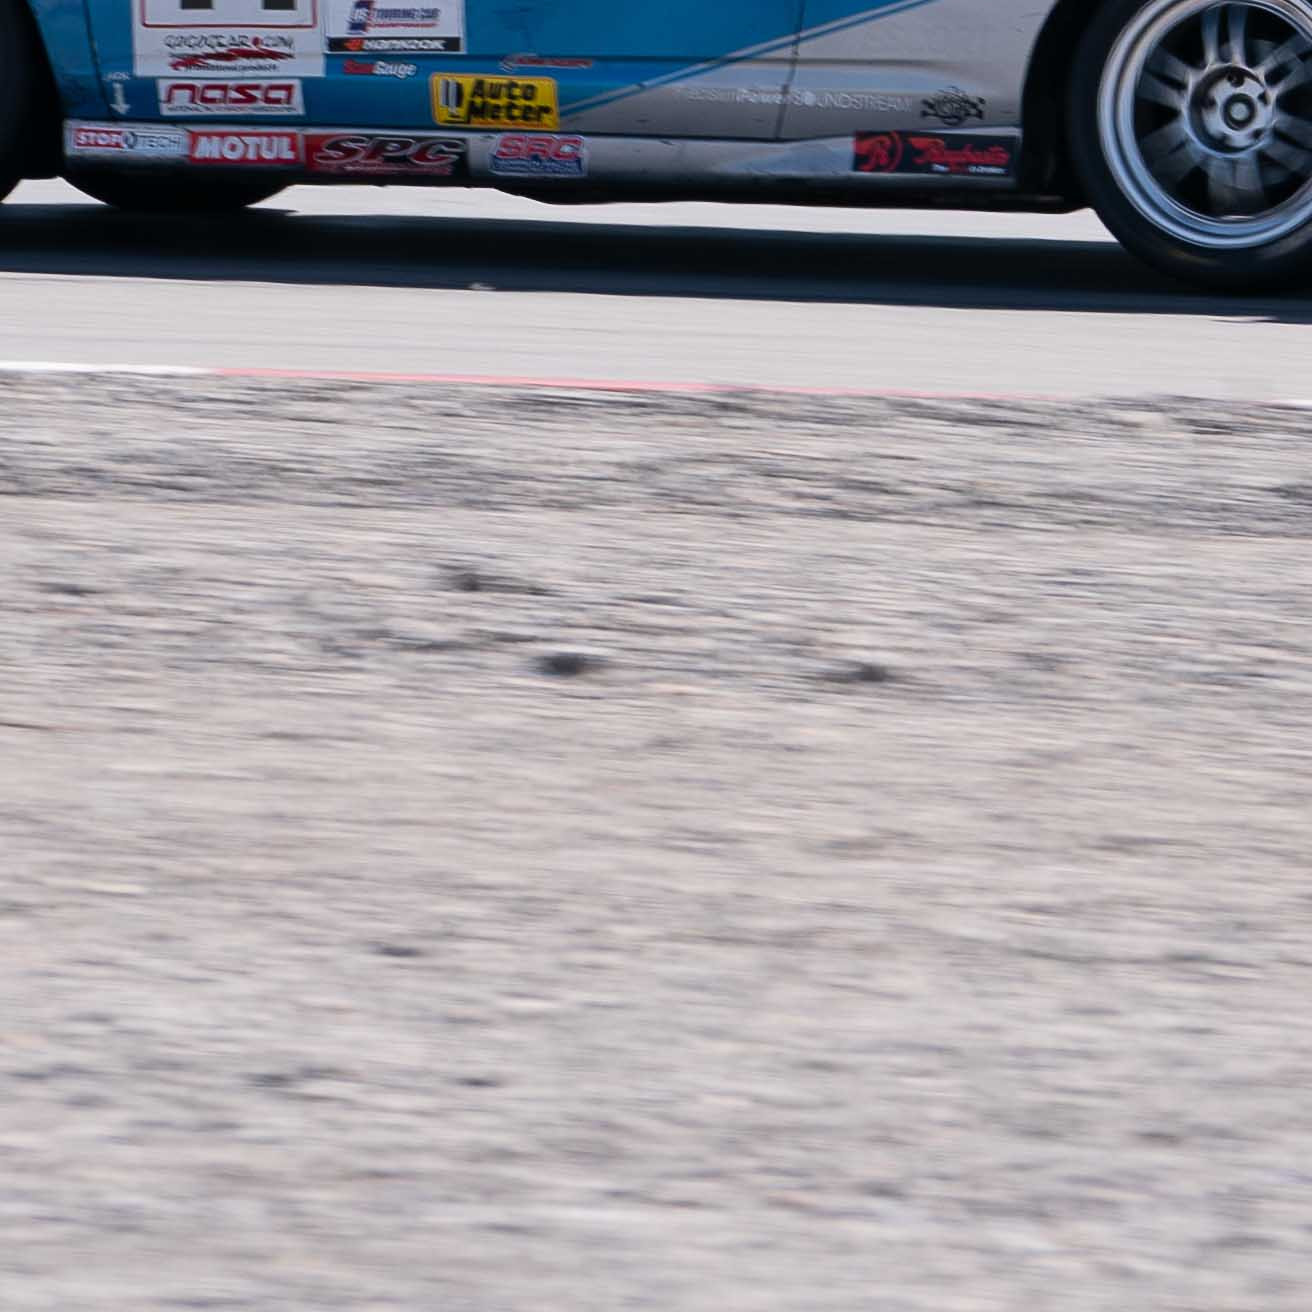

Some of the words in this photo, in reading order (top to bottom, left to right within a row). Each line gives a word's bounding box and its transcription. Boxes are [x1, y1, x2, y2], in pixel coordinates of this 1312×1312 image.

[164, 83, 296, 105] nasa
[472, 79, 538, 101] Auto
[468, 100, 553, 123] Meter
[194, 135, 295, 160] MOTUL
